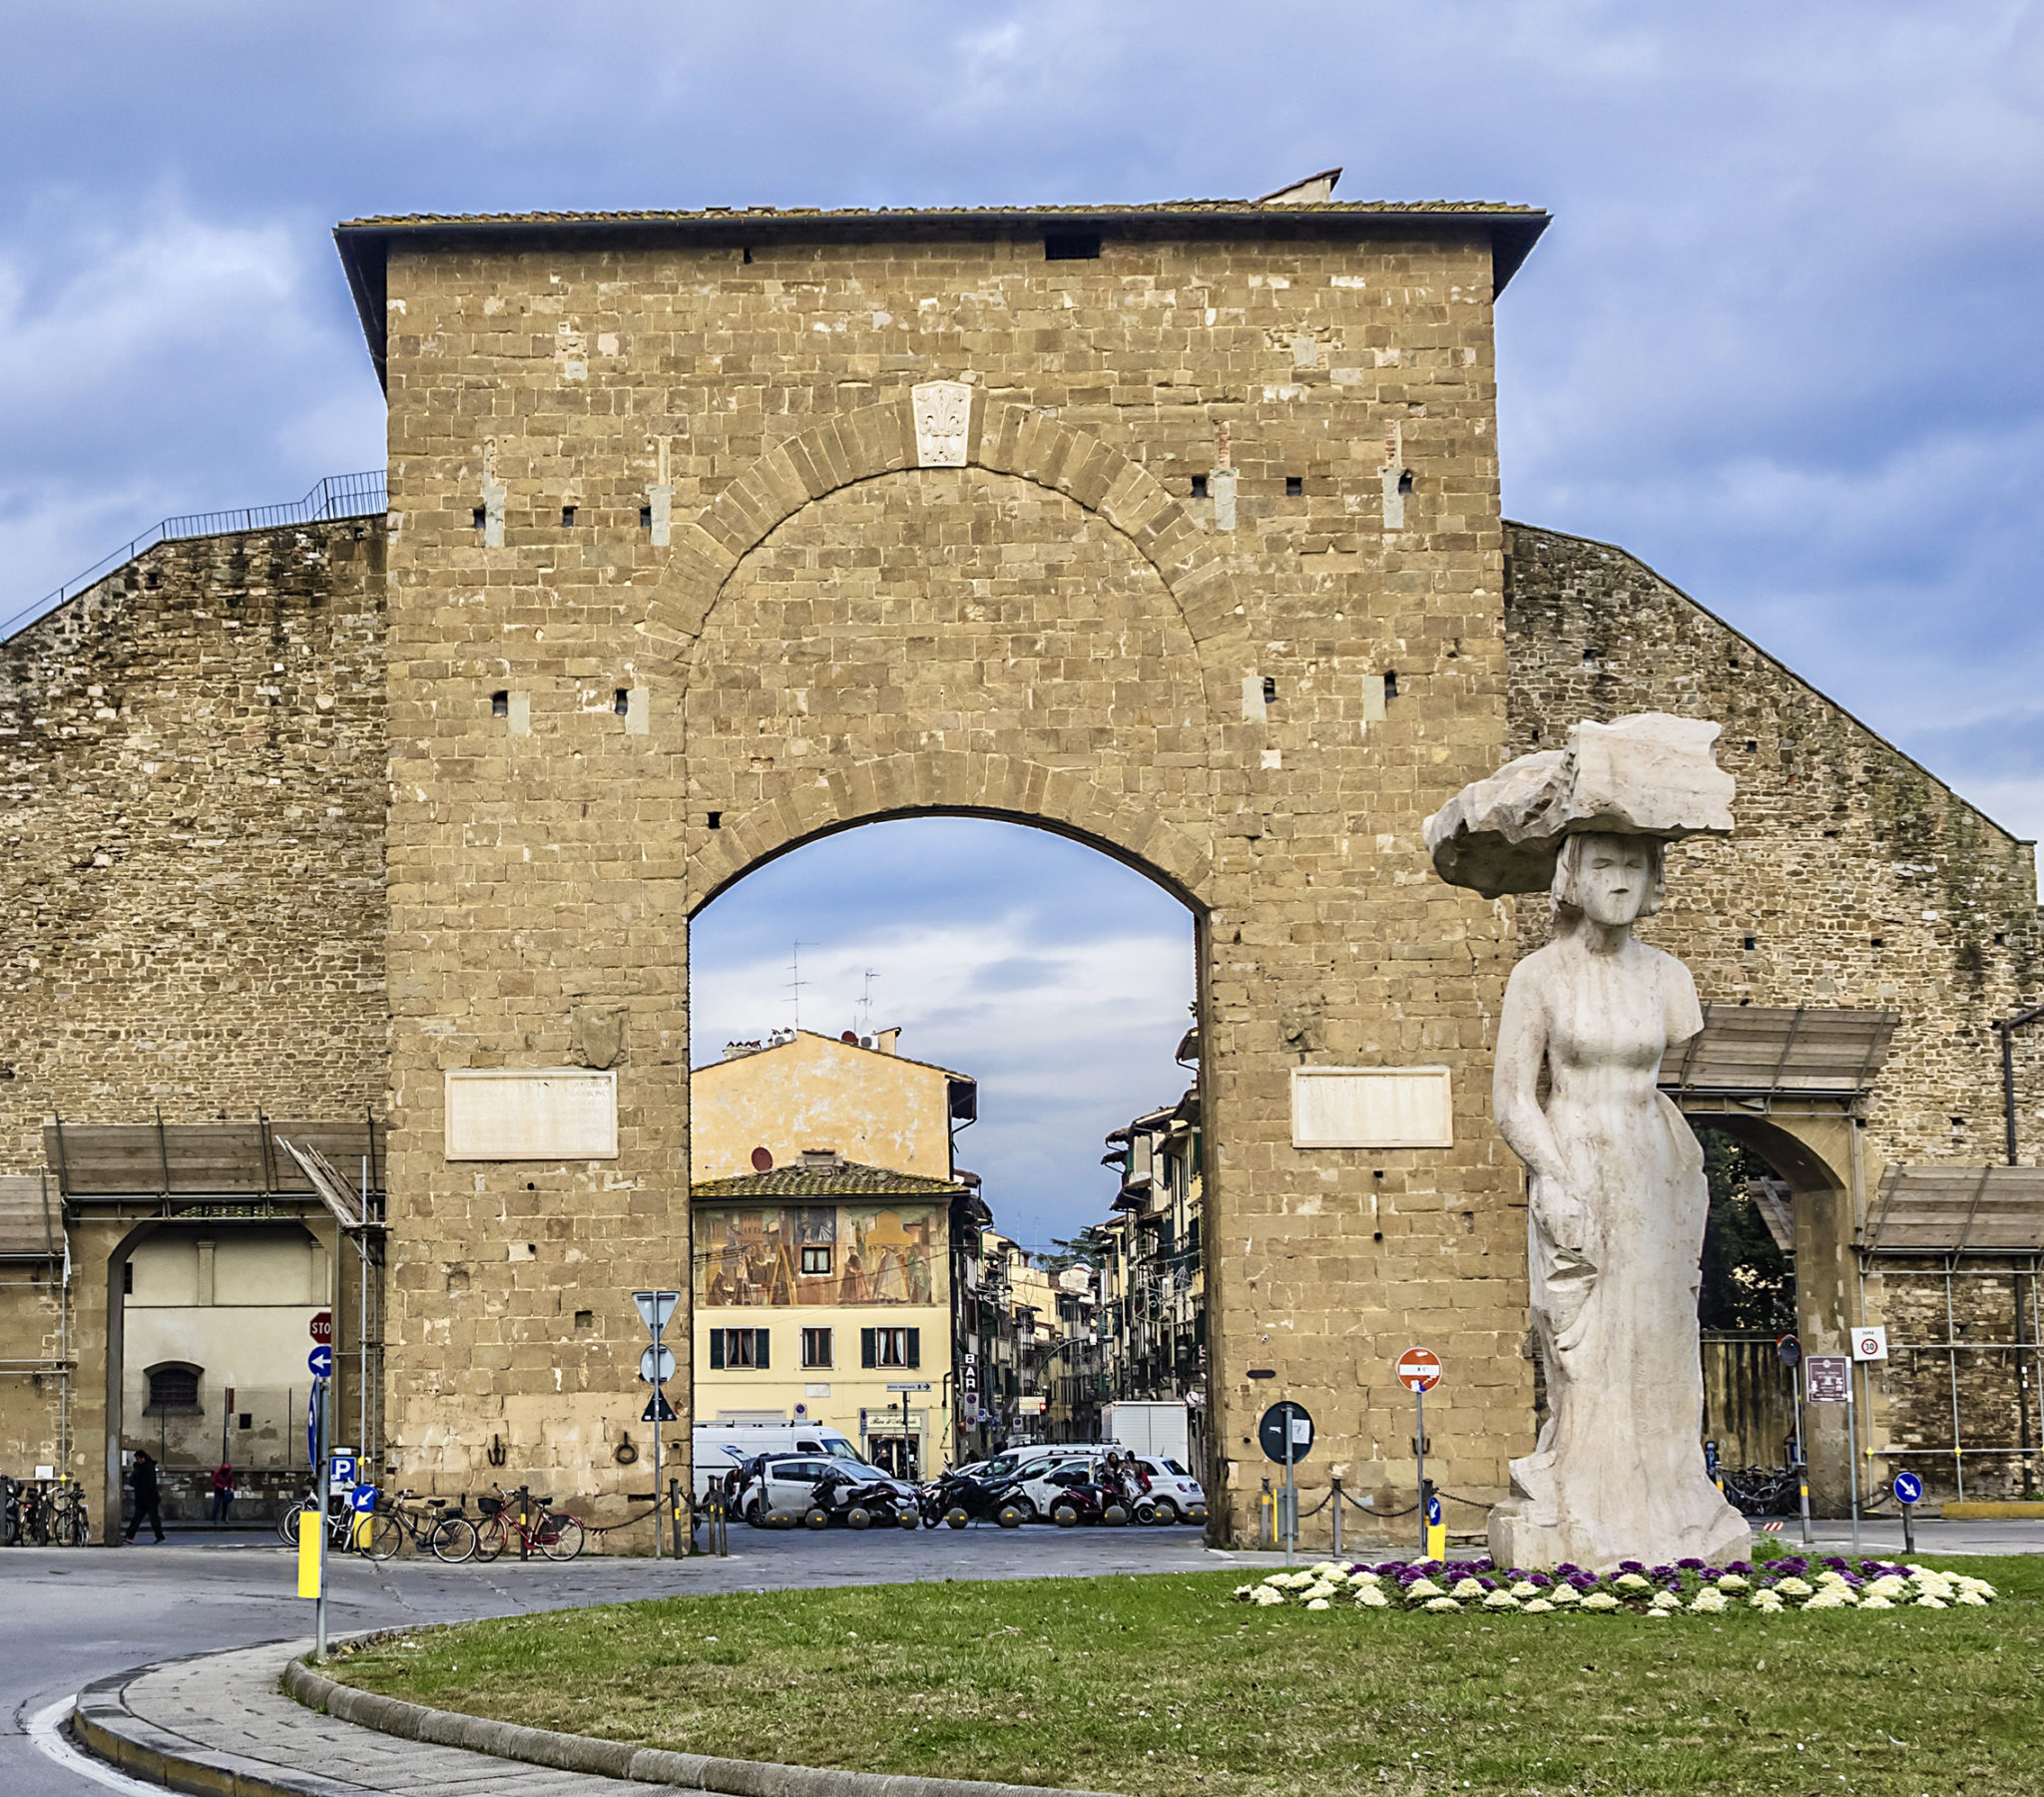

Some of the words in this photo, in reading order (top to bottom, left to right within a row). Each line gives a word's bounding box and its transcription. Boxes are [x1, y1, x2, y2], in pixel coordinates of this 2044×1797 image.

[311, 1322, 331, 1334] STO
[1864, 1342, 1874, 1351] 30
[965, 1354, 975, 1388] BAR
[335, 1460, 350, 1480] P
